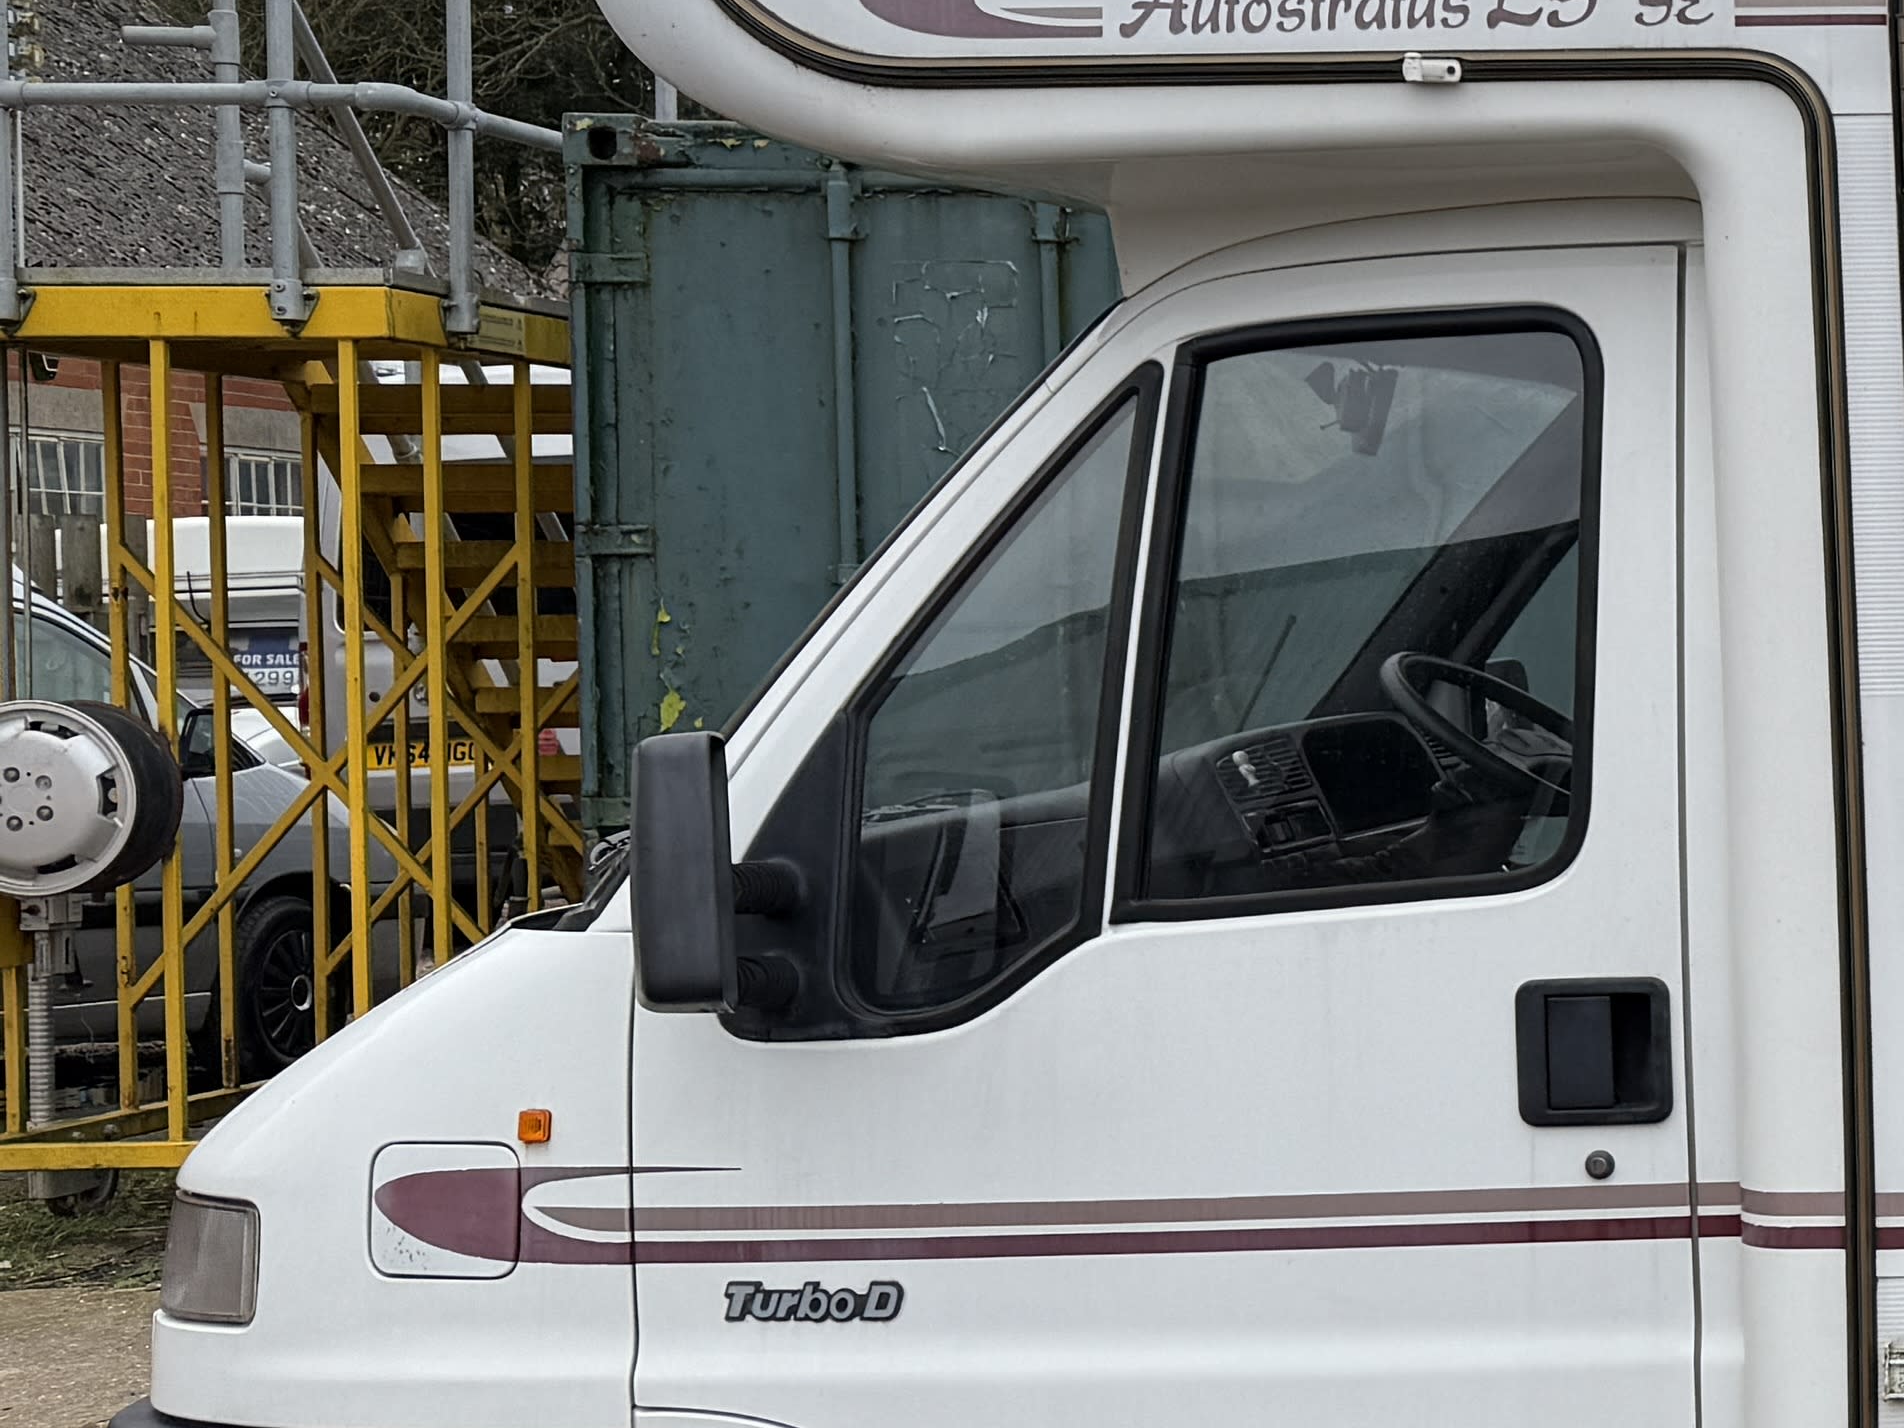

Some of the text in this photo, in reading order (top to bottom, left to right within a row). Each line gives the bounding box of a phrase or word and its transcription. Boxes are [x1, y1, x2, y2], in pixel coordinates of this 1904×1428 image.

[233, 653, 299, 665] FOR SALE
[245, 670, 294, 686] 299
[724, 1281, 859, 1321] Turbo
